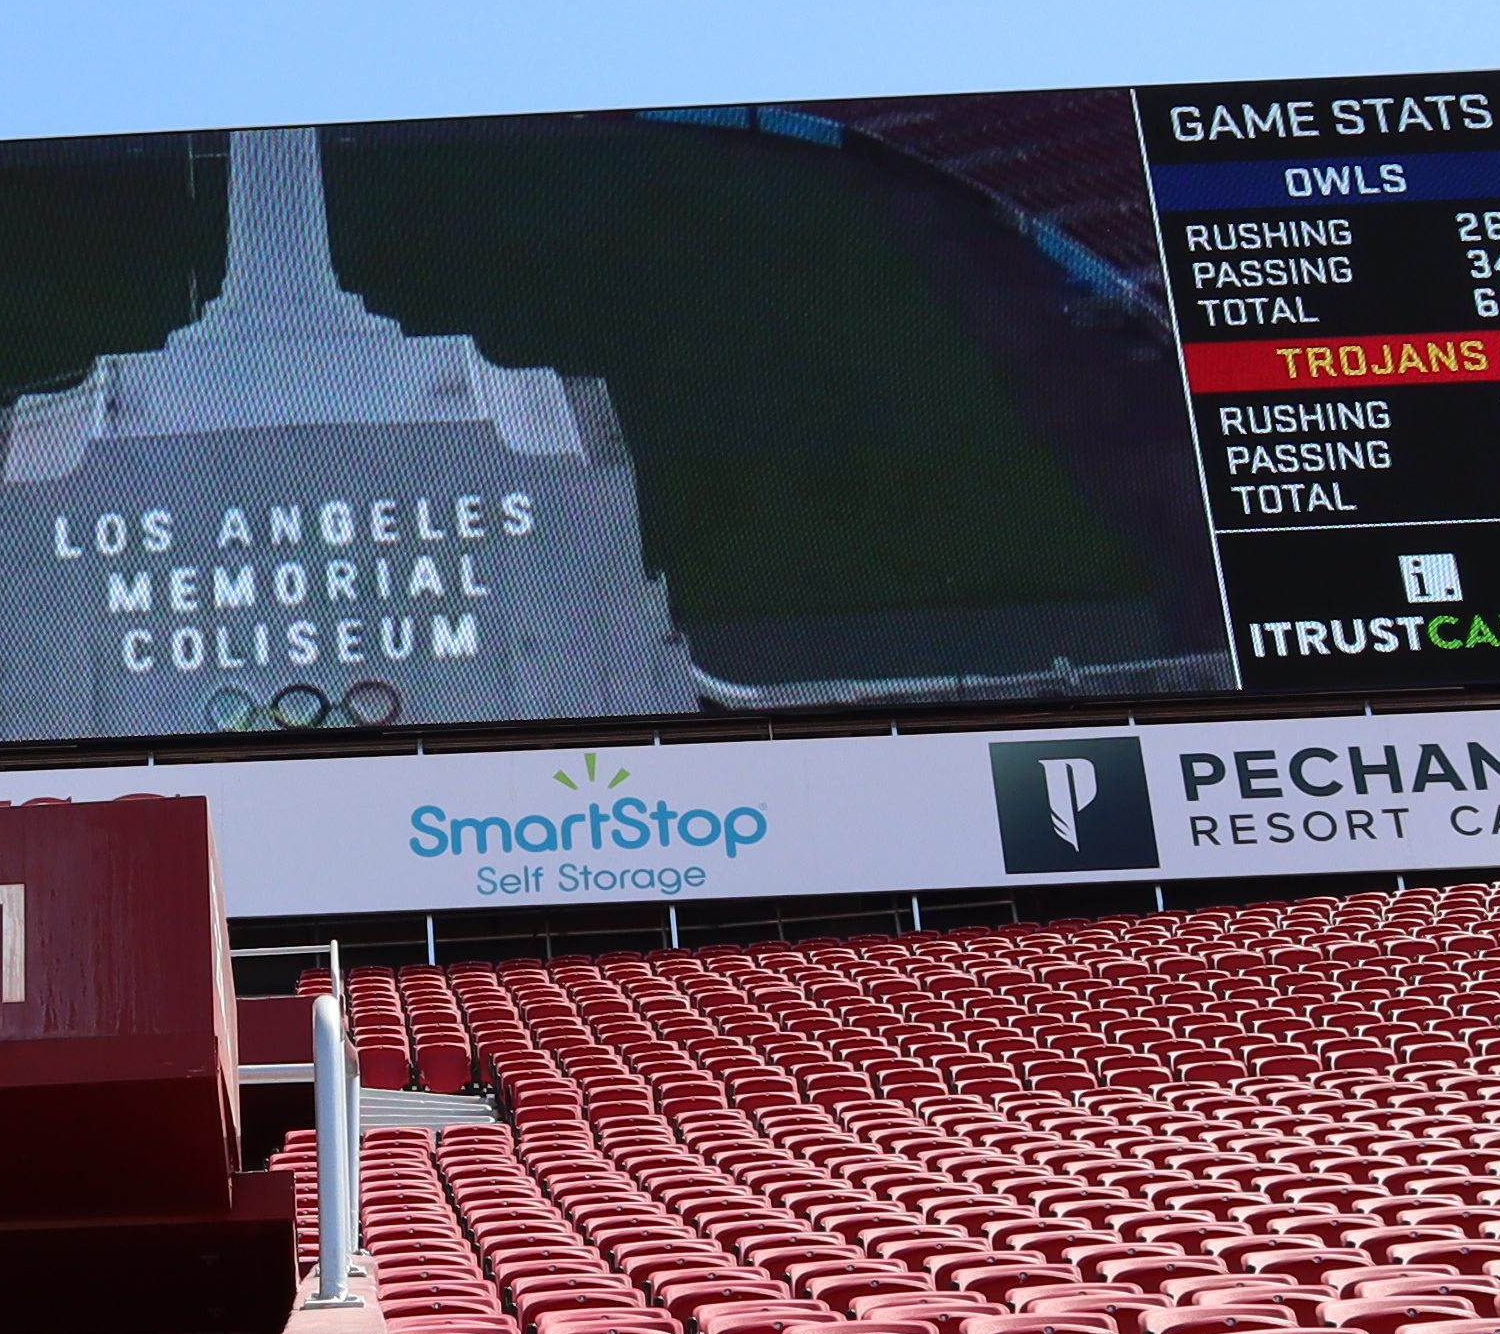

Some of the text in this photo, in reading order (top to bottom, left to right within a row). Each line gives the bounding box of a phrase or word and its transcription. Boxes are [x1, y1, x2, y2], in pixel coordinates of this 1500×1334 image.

[1169, 93, 1494, 142] GAME STATS
[1285, 163, 1408, 198] OWLS
[1186, 218, 1352, 252] RUSHING
[1193, 256, 1353, 289] PASSING
[1197, 296, 1320, 327] TOTAL
[1276, 340, 1490, 379] TROJANS
[1219, 400, 1392, 436] RUSHING
[1227, 440, 1392, 474] PASSING
[1231, 482, 1358, 515] TOTAL
[52, 492, 535, 560] LOS ANGELES
[107, 553, 491, 617] MEMORIAL
[121, 612, 482, 672] COLISEUM
[1189, 806, 1410, 850] RESORT
[476, 859, 707, 896] Self Storage
